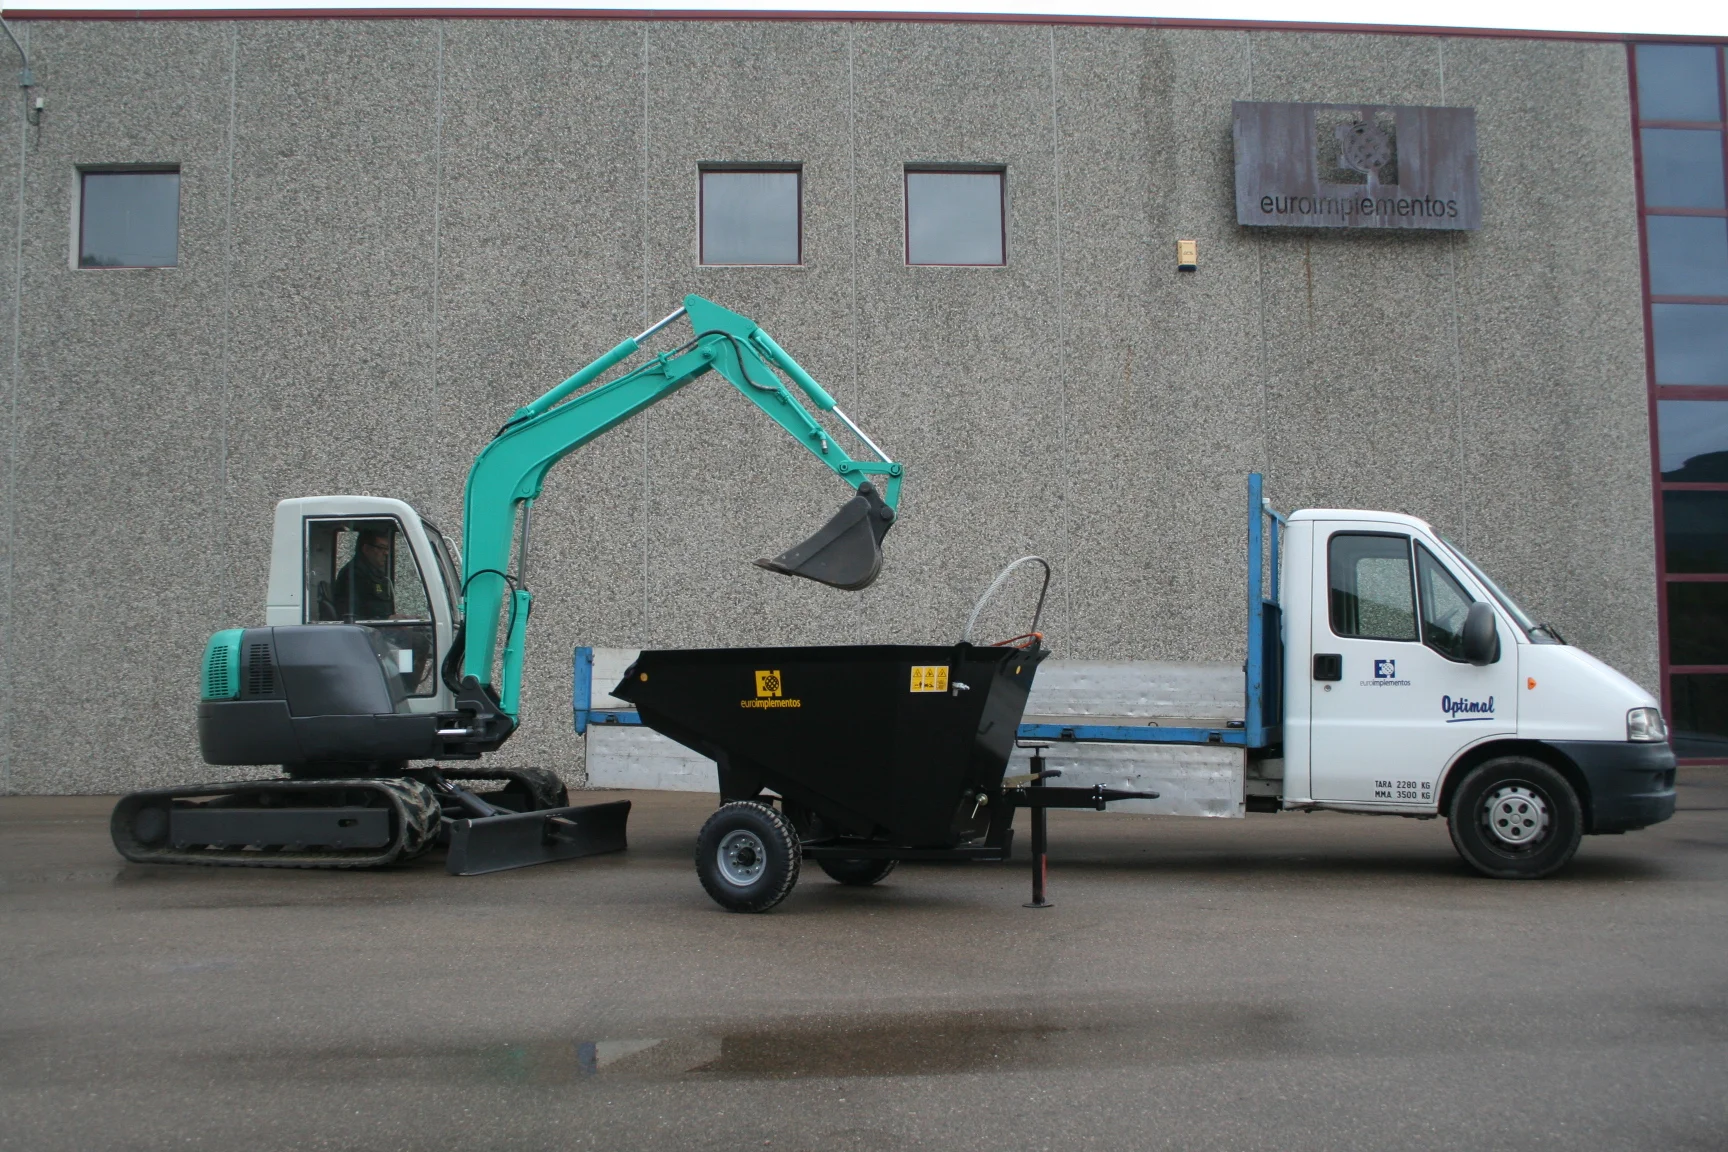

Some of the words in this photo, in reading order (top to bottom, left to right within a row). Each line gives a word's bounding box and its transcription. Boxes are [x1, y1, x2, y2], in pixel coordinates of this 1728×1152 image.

[1260, 194, 1458, 221] euroimplementos
[1360, 679, 1411, 688] euroimplementos
[740, 697, 801, 710] euroimplementos
[1441, 695, 1495, 718] Optimal
[1375, 780, 1392, 788] TARA
[1397, 780, 1417, 789] 2280
[1421, 782, 1431, 790] KG
[1375, 790, 1392, 799] MMA
[1397, 790, 1417, 799] 3500
[1421, 791, 1431, 800] KG
